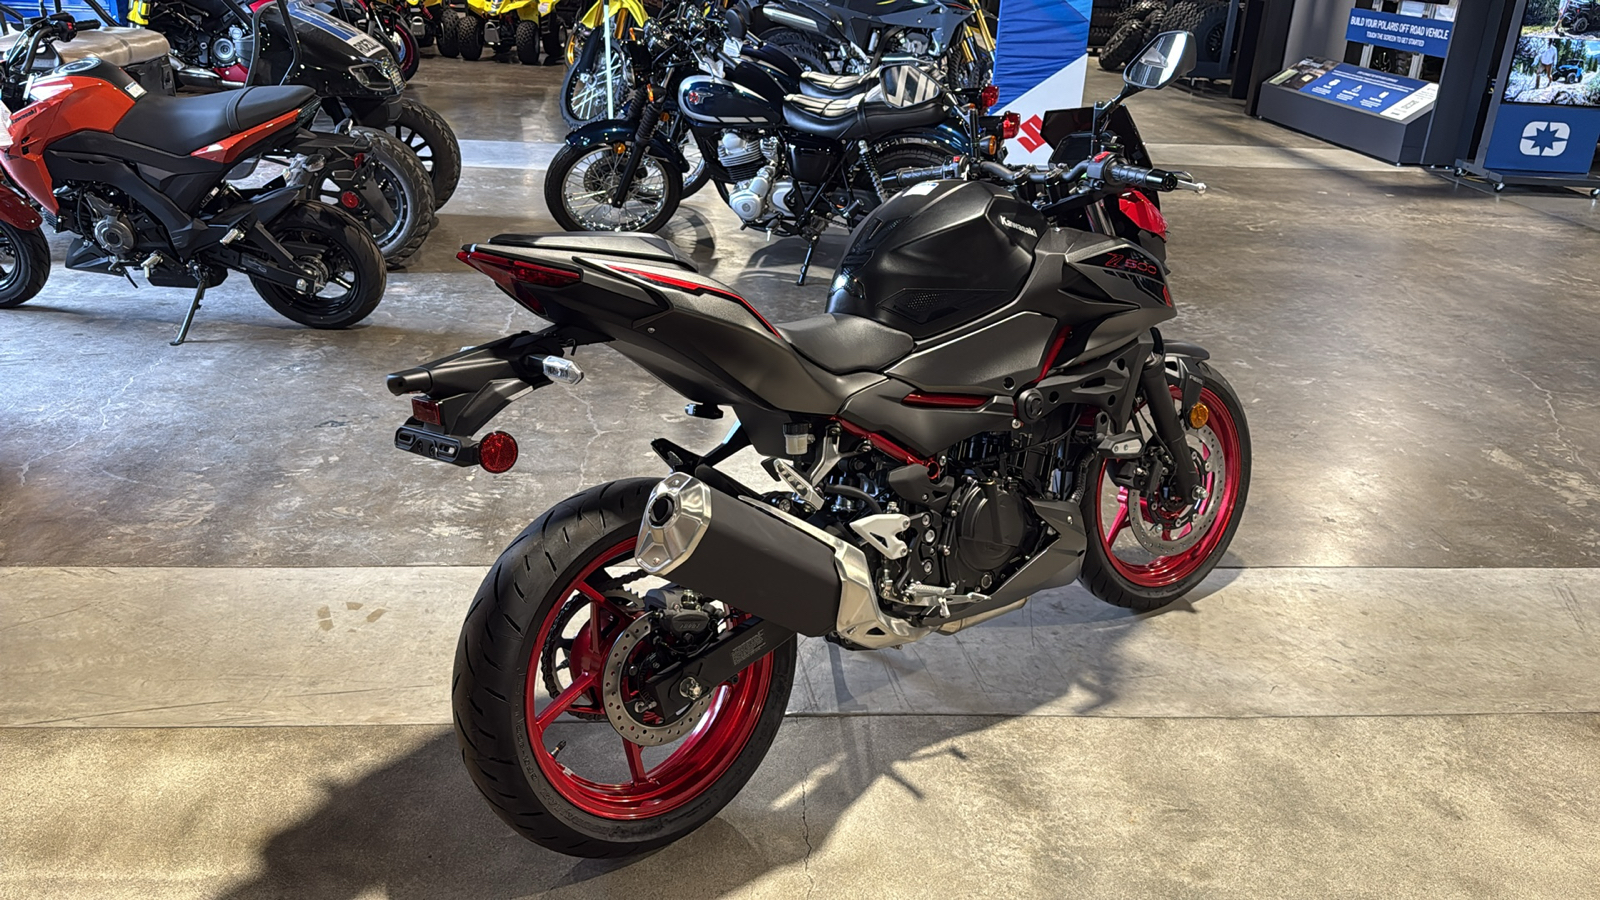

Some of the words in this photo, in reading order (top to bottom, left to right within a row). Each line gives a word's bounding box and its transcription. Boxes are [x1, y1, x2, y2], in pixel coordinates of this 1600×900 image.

[1350, 16, 1365, 26] BUILD
[1365, 18, 1378, 29] YOUR
[1378, 20, 1399, 32] POLARIS
[1399, 23, 1410, 34] OFF
[1410, 25, 1425, 36] ROAD
[1425, 27, 1450, 40] VEHICLE
[1383, 33, 1397, 42] SCREEN
[1408, 38, 1425, 47] STARTED
[999, 214, 1038, 238] Kawasaki
